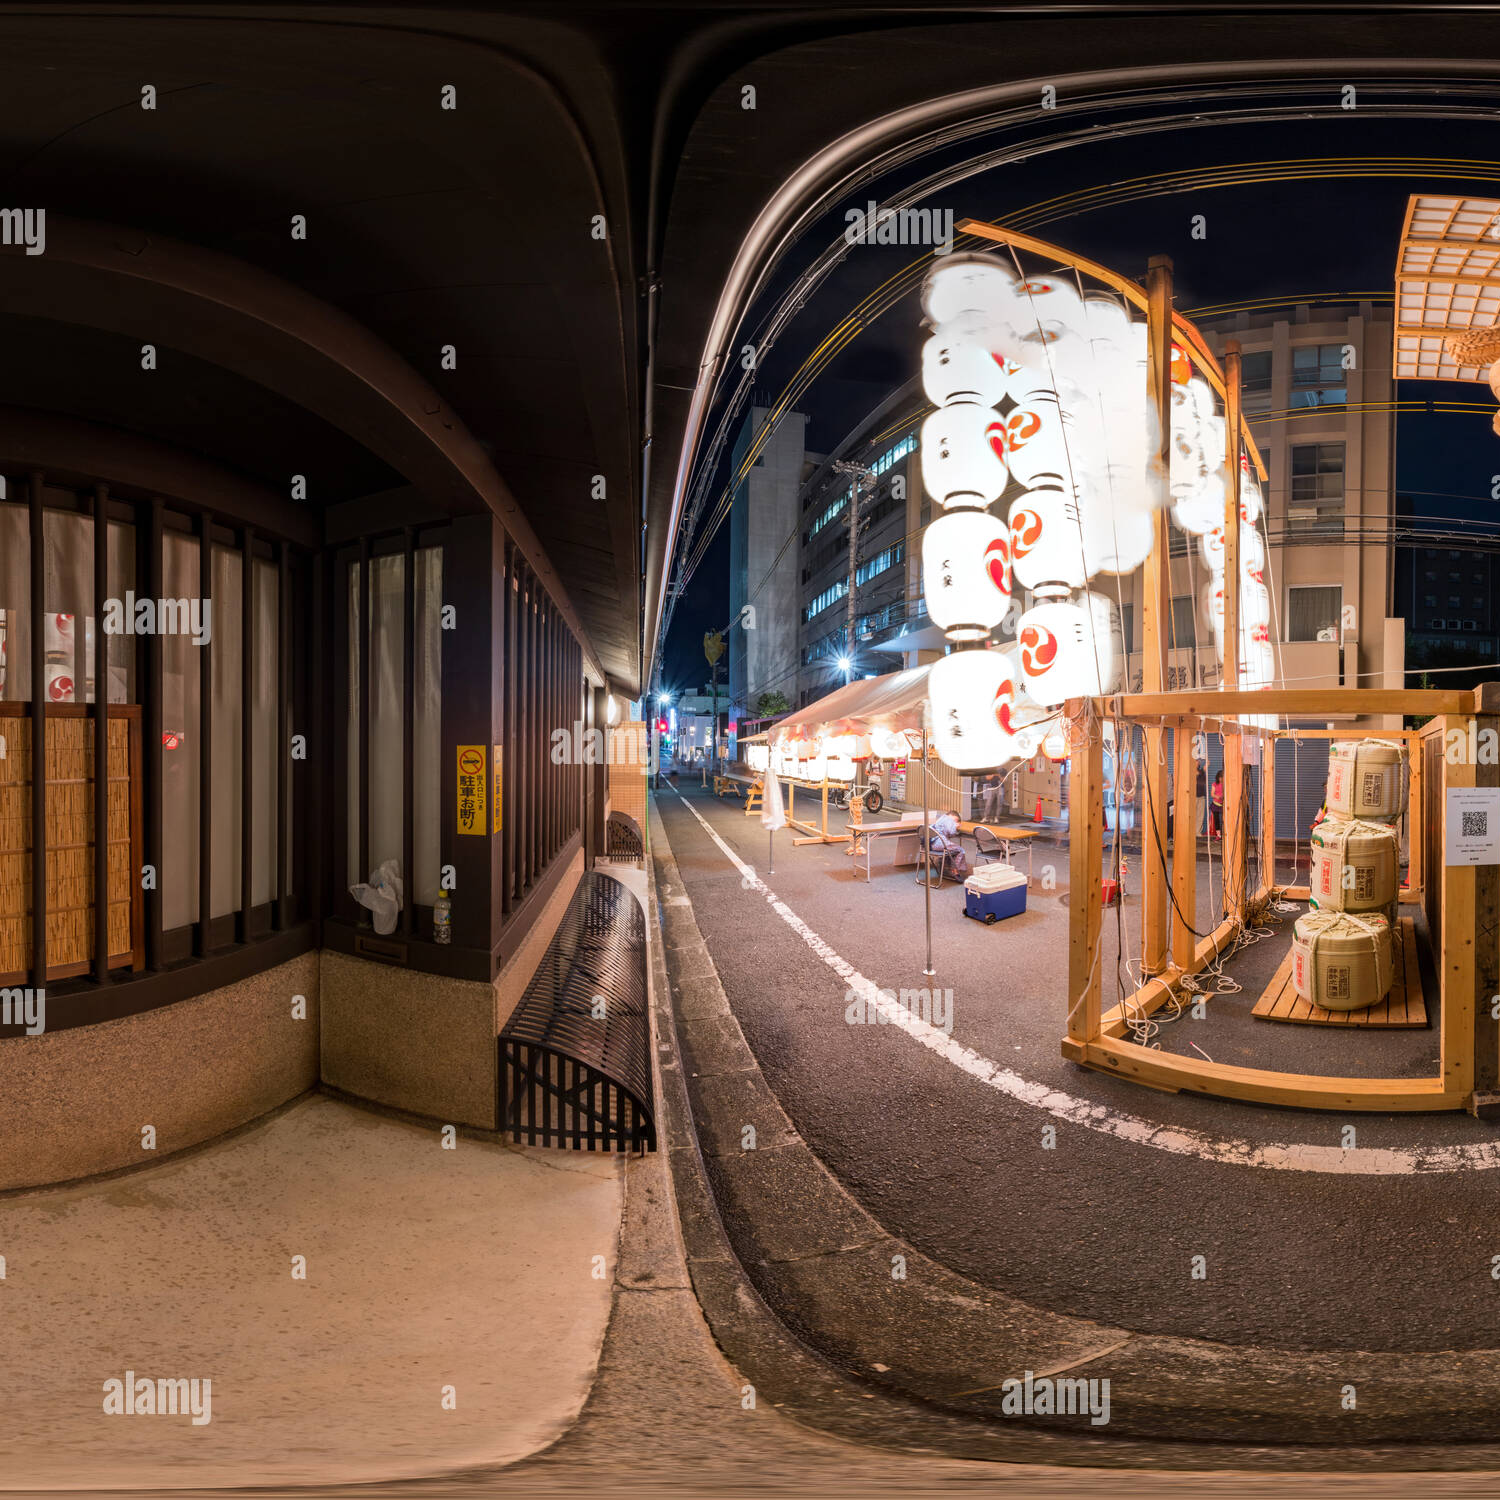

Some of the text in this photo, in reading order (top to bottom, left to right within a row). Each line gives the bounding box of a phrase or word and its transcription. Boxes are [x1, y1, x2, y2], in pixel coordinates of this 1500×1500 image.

[459, 775, 476, 830] 駐車お断り
